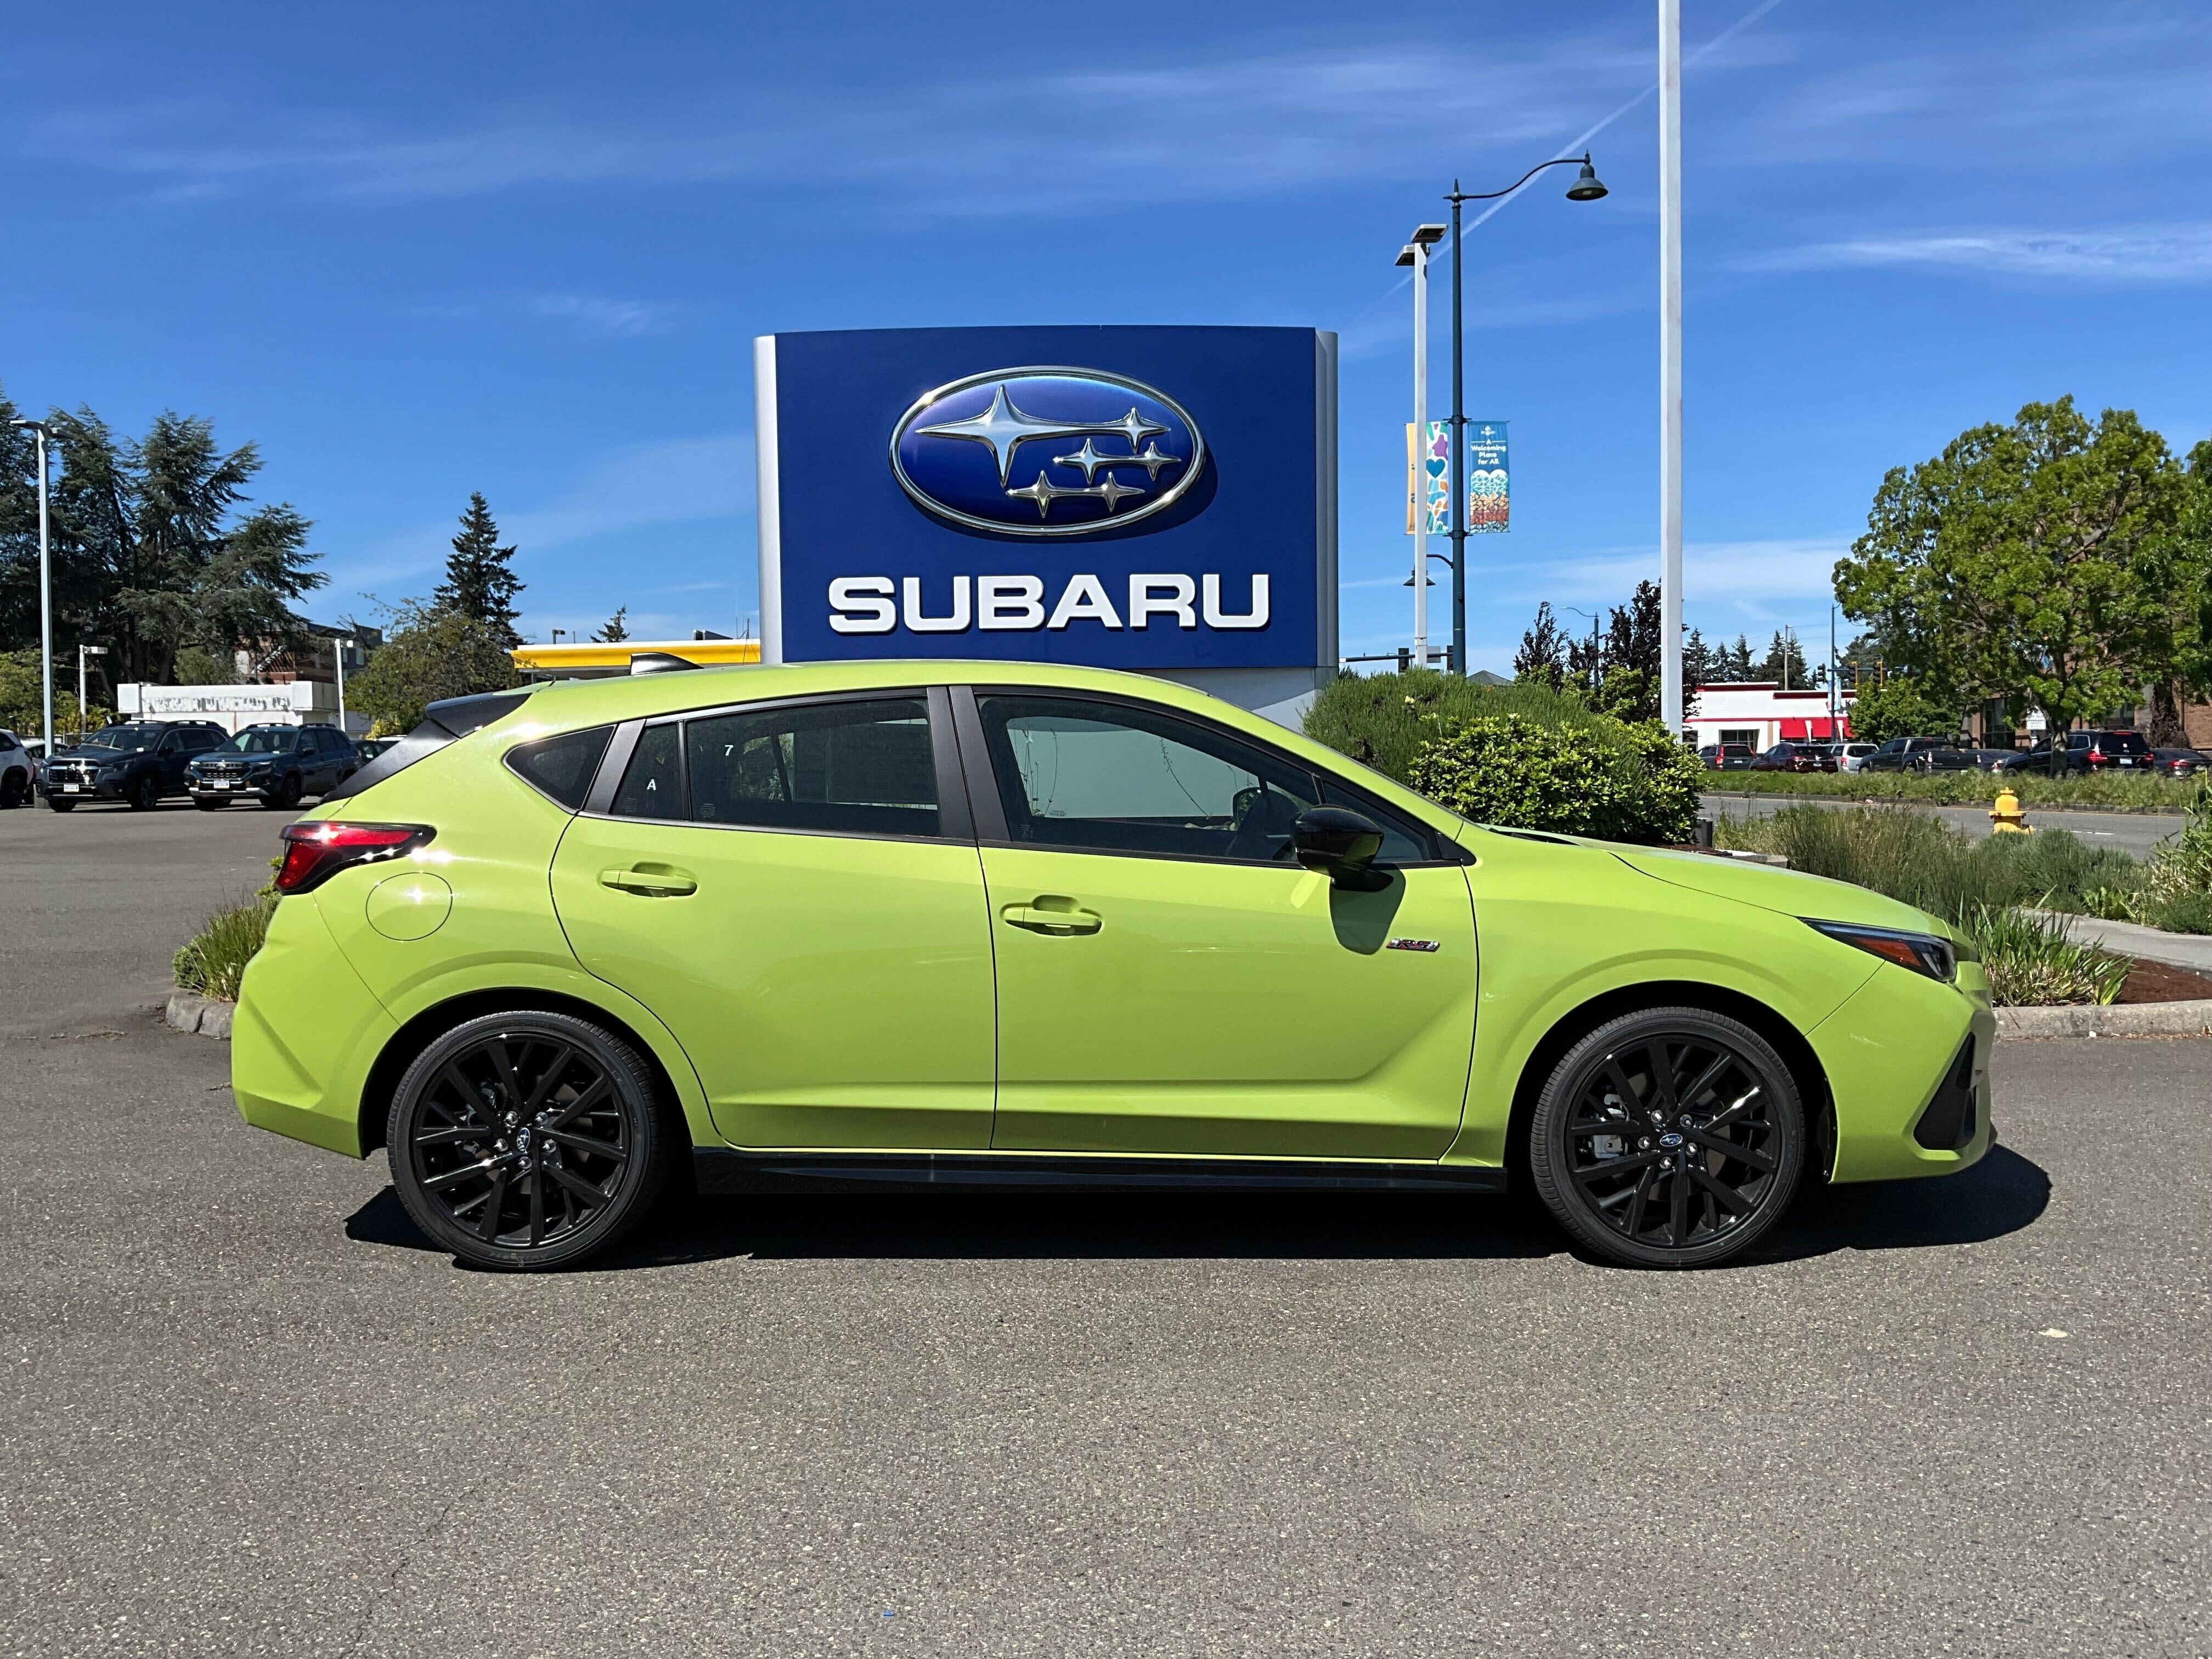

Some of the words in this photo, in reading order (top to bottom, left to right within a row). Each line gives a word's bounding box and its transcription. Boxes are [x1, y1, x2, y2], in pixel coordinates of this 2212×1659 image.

[828, 573, 1269, 633] SUBARU
[724, 744, 734, 756] 7
[646, 778, 657, 791] A
